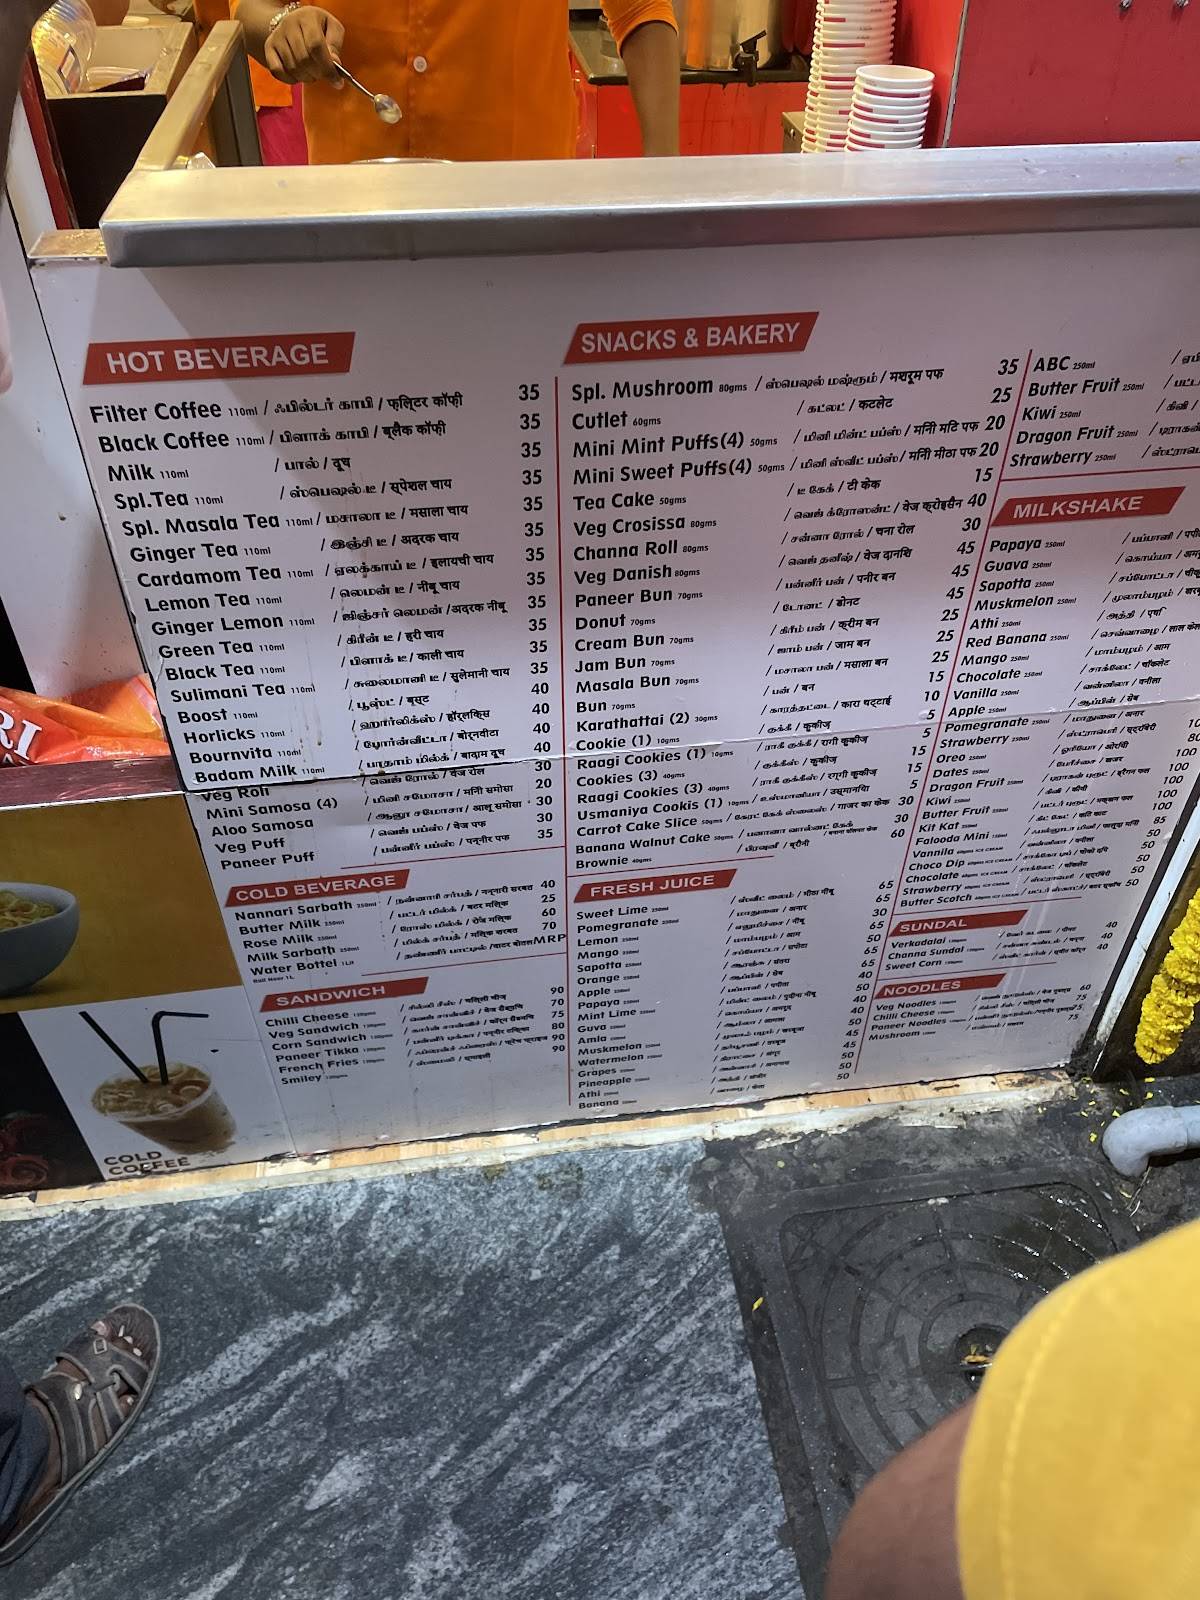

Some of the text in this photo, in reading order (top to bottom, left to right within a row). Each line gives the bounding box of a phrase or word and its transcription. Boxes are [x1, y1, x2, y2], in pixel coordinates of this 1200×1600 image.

[581, 322, 800, 354] SNACKS & BAKERY
[107, 343, 328, 374] HOT BEVERAGE
[1034, 356, 1095, 372] ABC 250ml
[572, 358, 1018, 403] Spl. Mushroom 80gms 35
[1028, 378, 1120, 396] Butter Fruit
[518, 384, 540, 400] 35
[990, 388, 1012, 404] 25
[90, 401, 257, 423] Filter Coffee 110ml
[572, 410, 661, 430] Cutlet 60gms
[1022, 406, 1057, 421] Kiwi
[98, 431, 229, 452] Black Coffee
[573, 415, 1006, 458] Mini Mint Puffs(4) 20
[1016, 426, 1114, 444] Dragon Fruit
[521, 442, 541, 458] 35
[108, 464, 189, 481] Milk 110ml
[573, 458, 752, 485] Mini Sweet Puffs(4)
[975, 468, 992, 482] 15
[114, 492, 189, 512] Spl.Tea
[573, 492, 654, 511] Tea Cake
[1013, 496, 1144, 519] MILKSHAKE
[122, 514, 313, 539] Spl. Masala Tea 110ml
[524, 522, 544, 536] 35
[574, 516, 685, 537] Veg Crosissa
[130, 543, 238, 563] Ginger Tea
[990, 538, 1042, 554] Papaya
[984, 560, 1028, 572] Guava
[137, 566, 282, 588] Cardamom Tea
[979, 578, 1031, 593] Sapotta
[144, 593, 250, 612] Lemon Tea
[975, 596, 1054, 611] Muskmelon
[152, 616, 314, 636] Ginger Lemon 110ml
[576, 614, 626, 630] Donut
[966, 632, 1046, 648] Red Banana
[171, 683, 286, 702] Sulimani Tea
[953, 687, 997, 700] Vanilla
[178, 683, 548, 723] Boost 40
[948, 705, 985, 718] Apple
[576, 712, 690, 732] Karathattai (2)
[944, 718, 1028, 732] Pomegranate
[184, 729, 256, 744] Horlicks
[576, 734, 652, 751] Cookie (1)
[189, 748, 272, 764] Bournvita
[195, 742, 550, 783] Badam Milk 40
[577, 748, 706, 770] Raagi Cookies (1)
[932, 748, 1197, 778] Dates 100
[936, 753, 966, 763] Oreo
[202, 790, 232, 802] Veg
[206, 778, 552, 820] Mini Samosa (4) 20
[578, 798, 722, 820] Usmaniya Cookis (1)
[212, 818, 314, 836] Aloo Samosa
[576, 816, 698, 836] Carrot Cake Slice
[918, 822, 960, 832] Kit Kat
[215, 838, 285, 854] Veg Puff
[221, 828, 552, 870] Paneer Puff 35
[576, 856, 628, 868] Brownie
[236, 876, 396, 900] COLD BEVERAGE
[591, 875, 714, 896] FRESH JUICE
[901, 899, 934, 907] Butter
[936, 894, 972, 904] Scotch
[1124, 878, 1138, 887] 50
[235, 880, 555, 920] Nannari Sarbath 40
[576, 880, 894, 920] Sweet Lime 65
[239, 919, 320, 934] Butter Milk
[900, 919, 968, 932] SUNDAL
[578, 936, 618, 946] Lemon
[891, 938, 946, 948] Verkadalai
[250, 934, 566, 976] Water Bottel MRP
[885, 959, 942, 970] Sweet Corn
[577, 974, 620, 985] Orange
[884, 981, 961, 996] NOODLES
[276, 986, 384, 1006] SANDWICH
[898, 1000, 936, 1008] Noodles
[266, 1016, 298, 1027] Chilli
[302, 1012, 349, 1022] Cheese
[550, 986, 564, 994] 90
[269, 1030, 294, 1040] Veg
[298, 1022, 359, 1035] Sandwich
[868, 1031, 920, 1041] Mushroom
[279, 1062, 322, 1074] French
[328, 1058, 358, 1068] Fries
[578, 1054, 644, 1066] Watermelon
[104, 1152, 162, 1165] COLD
